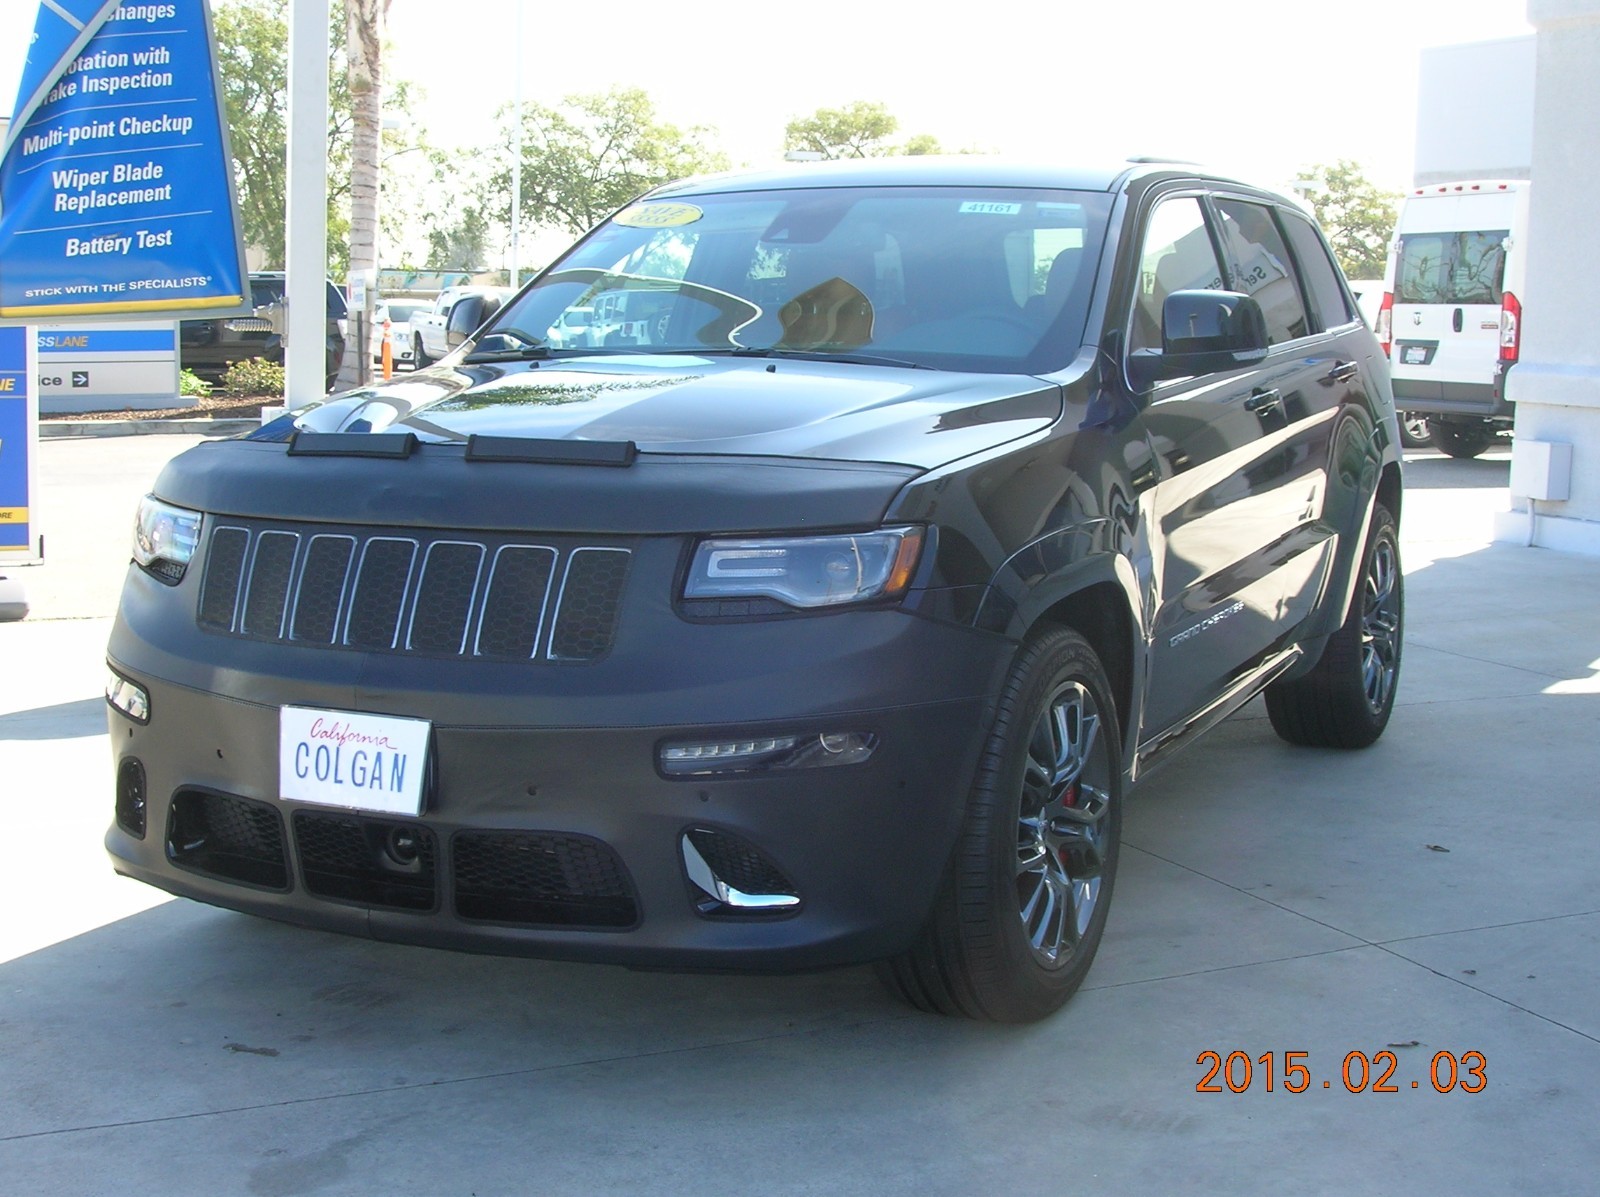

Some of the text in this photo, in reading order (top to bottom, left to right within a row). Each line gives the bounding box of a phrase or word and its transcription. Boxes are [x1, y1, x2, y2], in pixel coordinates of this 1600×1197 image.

[64, 46, 170, 76] otation with
[42, 70, 173, 105] rake Inspection
[23, 115, 193, 156] Multi-point Checkup
[52, 162, 164, 191] Wiper Blade
[54, 184, 172, 214] Replacement
[967, 203, 1012, 213] 41161
[66, 230, 173, 257] Battery Test
[25, 288, 62, 298] STICK
[65, 284, 99, 295] WITH
[101, 282, 126, 292] THE
[310, 717, 398, 750] California
[295, 741, 407, 793] COLGAN
